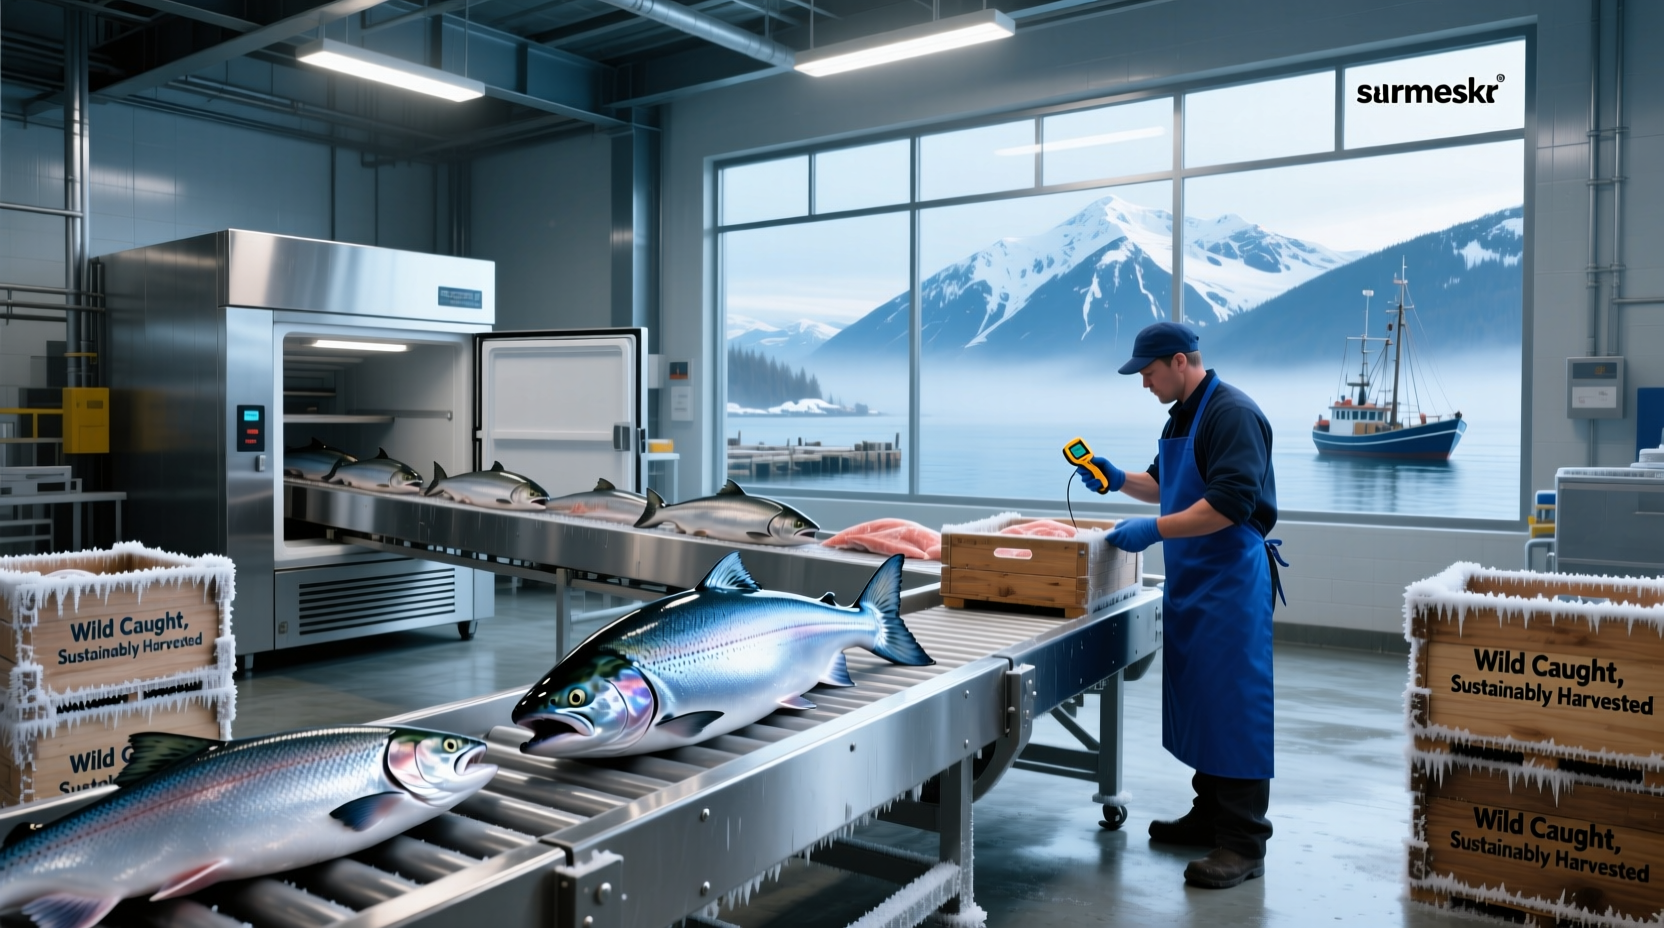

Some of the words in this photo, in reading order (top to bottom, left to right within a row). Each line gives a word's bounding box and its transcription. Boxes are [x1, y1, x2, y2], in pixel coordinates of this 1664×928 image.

[70, 618, 114, 642] Wild
[120, 611, 189, 636] Caught,
[58, 640, 139, 665] Sustainably
[1474, 648, 1525, 675] Wild
[1532, 654, 1624, 689] Caught,
[1451, 674, 1553, 708] Sustainably
[1557, 686, 1654, 716] Harvested
[69, 746, 115, 774] Wild
[1473, 806, 1524, 835] Wild
[1530, 816, 1621, 855] Caught,
[1450, 830, 1551, 869] Sustainably
[1555, 849, 1650, 883] Harvested
